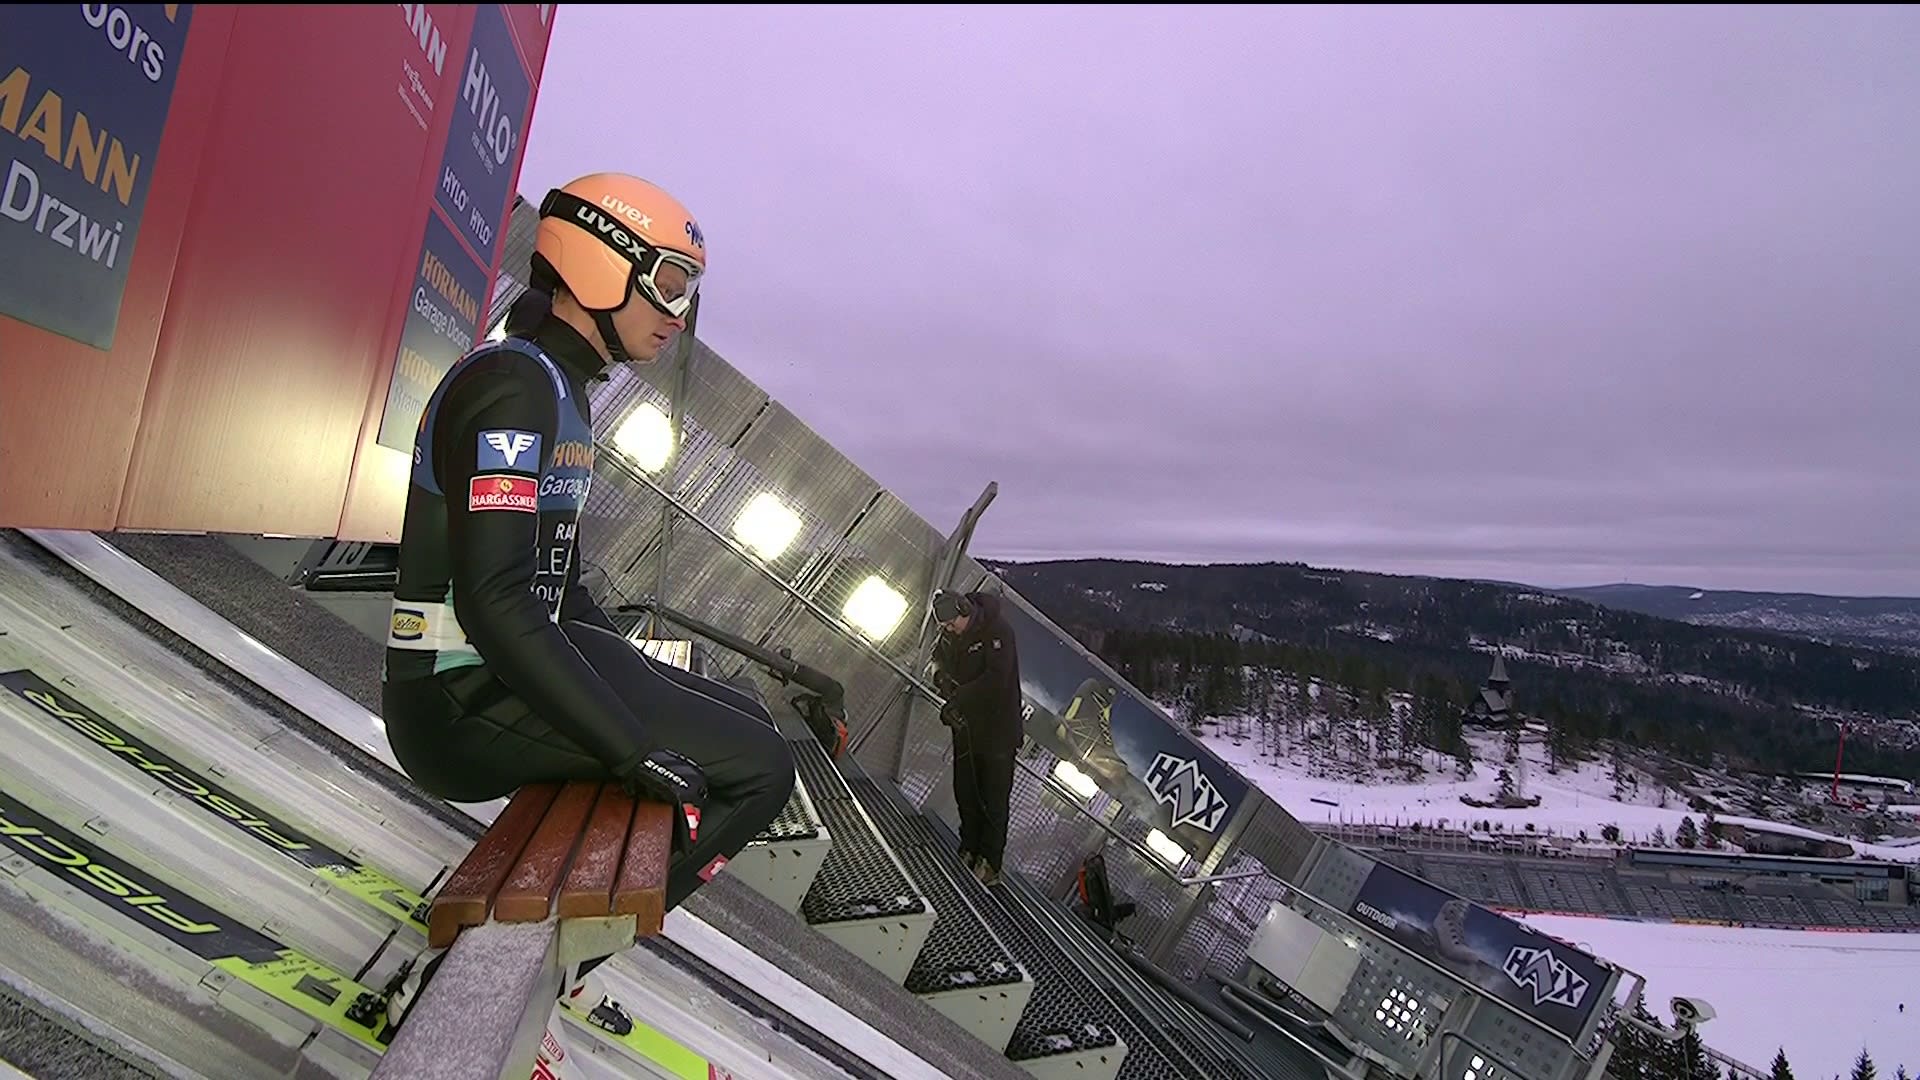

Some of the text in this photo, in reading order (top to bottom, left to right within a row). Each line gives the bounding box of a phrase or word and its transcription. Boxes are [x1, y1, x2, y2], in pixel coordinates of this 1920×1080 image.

[1, 159, 123, 269] Drzwi
[577, 206, 649, 261] uvex
[601, 195, 653, 229] uvex
[414, 286, 471, 353] Garage Doors
[24, 690, 311, 850] FISCHER
[1356, 902, 1398, 930] OUTDOOR
